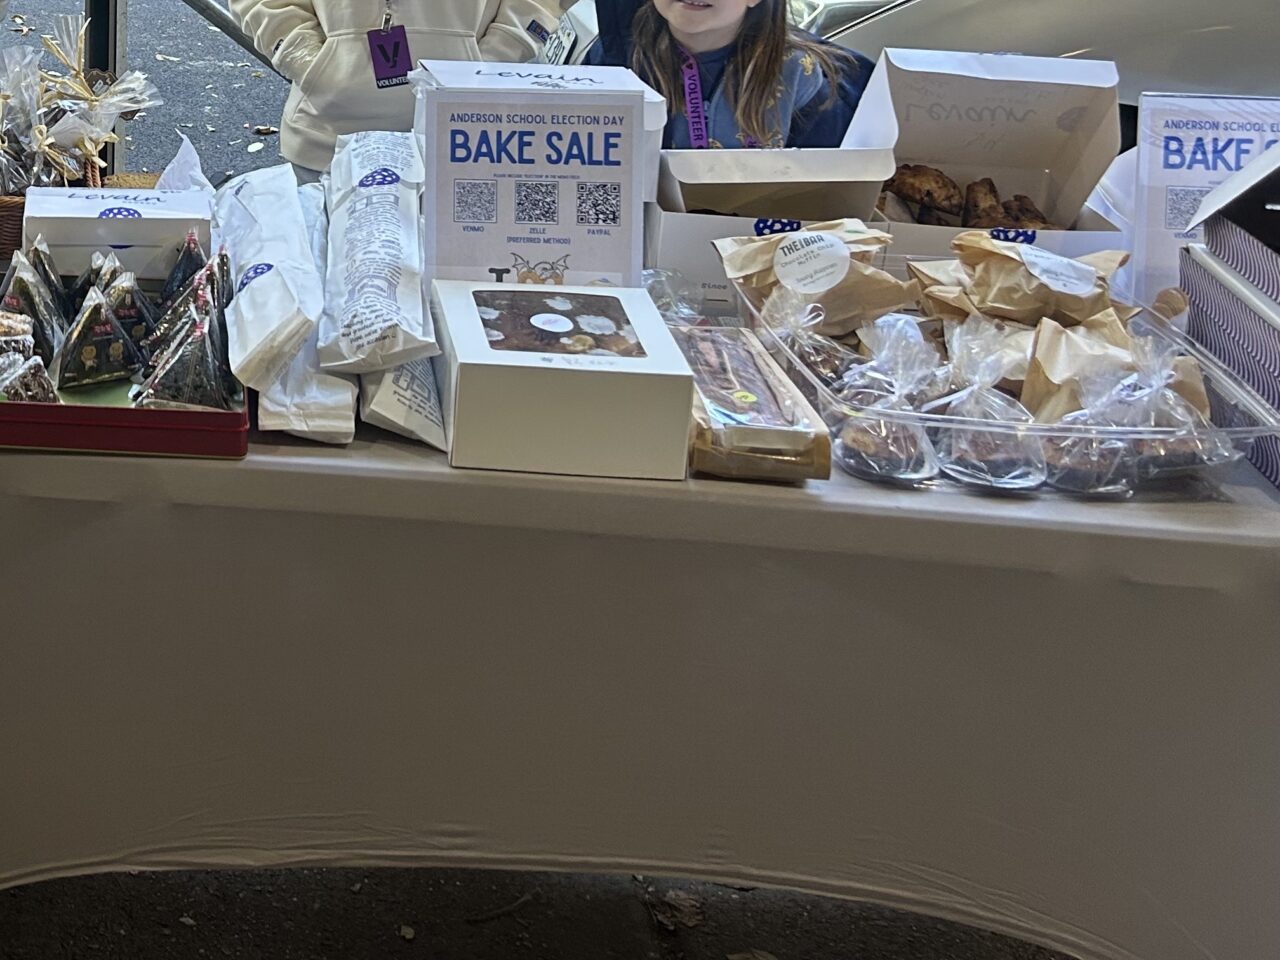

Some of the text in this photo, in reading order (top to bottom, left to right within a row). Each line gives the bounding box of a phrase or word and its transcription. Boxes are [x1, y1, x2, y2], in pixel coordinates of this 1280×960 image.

[377, 77, 408, 87] VOLUNTE
[475, 70, 604, 84] Levain
[686, 75, 704, 141] VOLUNTEER
[450, 113, 625, 126] ANDERSON SCHOOL ELECTION DAY
[1163, 120, 1219, 130] ANDERSON
[1223, 122, 1266, 133] SCHOOL
[450, 129, 535, 165] BAKE
[546, 131, 622, 166] SALE
[1163, 136, 1254, 171] BAKE
[68, 191, 166, 203] Levain
[529, 227, 546, 235] ZELLE
